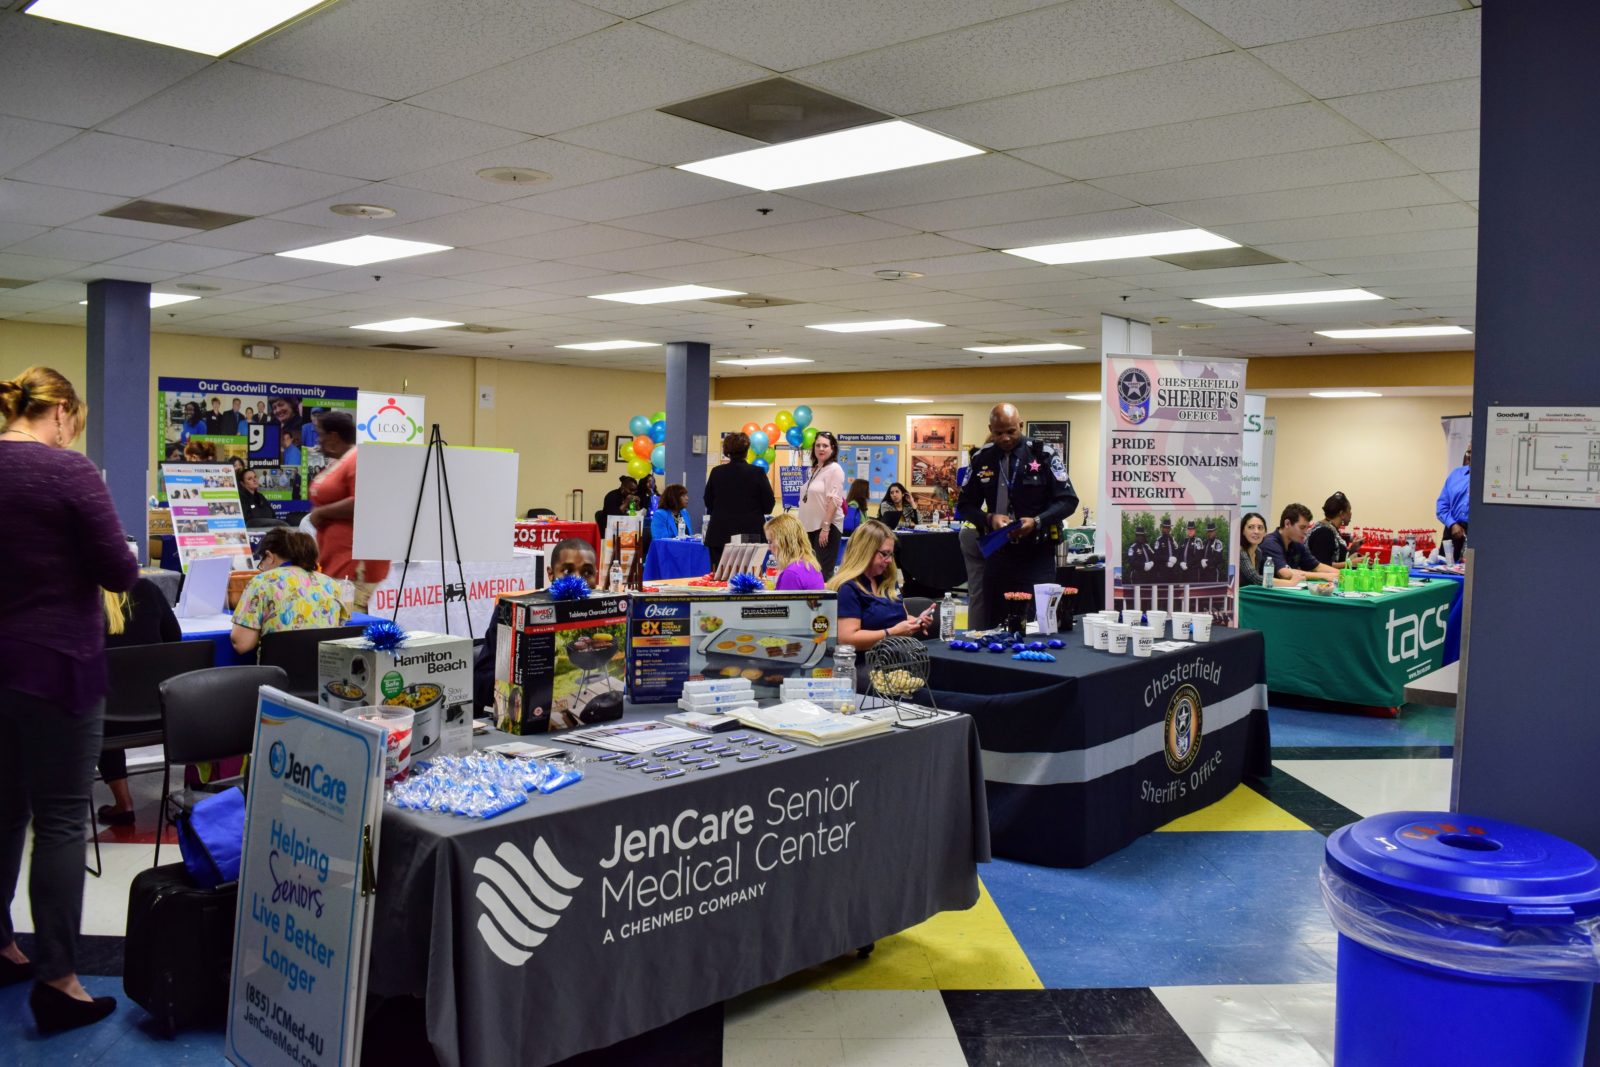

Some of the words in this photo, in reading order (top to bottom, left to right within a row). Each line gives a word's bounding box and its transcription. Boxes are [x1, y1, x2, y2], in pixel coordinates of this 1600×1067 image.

[198, 381, 219, 391] Our
[221, 382, 267, 394] Goodwill
[269, 385, 326, 398] Community
[1157, 377, 1239, 389] CHESTERFIELD
[1157, 389, 1239, 409] SHERIFF'S
[1178, 410, 1218, 421] OFFICE
[1111, 438, 1156, 450] PRIDE
[249, 459, 279, 467] goodwill
[1111, 454, 1239, 467] PROFESSIONALISM
[1111, 471, 1177, 482] HONESTY
[1111, 487, 1186, 499] INTEGRITY
[376, 584, 443, 610] DELHAIZE
[468, 577, 526, 601] AMERICA
[601, 599, 617, 607] 14-inch
[569, 611, 588, 619] Tabletop
[588, 607, 608, 616] Charcoal
[608, 606, 618, 614] Grill
[644, 603, 678, 618] Oster
[641, 620, 660, 635] 8X
[1385, 603, 1449, 664] tacs
[393, 650, 453, 668] Hamilton
[427, 658, 467, 675] Beach
[1144, 657, 1222, 708] Chesterfield
[448, 693, 469, 702] Cooker
[284, 752, 347, 805] JenCare
[1140, 779, 1187, 804] Sheriff's
[1190, 750, 1223, 790] Office
[599, 805, 754, 868] JenCare
[766, 777, 860, 826] Senior
[270, 818, 330, 883] Helping
[601, 842, 741, 918] Medical
[755, 821, 857, 872] Center
[269, 850, 325, 919] Seniors
[602, 928, 615, 945] A
[620, 906, 694, 940] CHENMED
[698, 881, 767, 916] COMPANY
[252, 892, 280, 934] Live
[284, 912, 335, 968] Better
[262, 935, 316, 994] Longer
[245, 982, 270, 1018] (855)
[271, 1003, 324, 1056] JCMed-4U
[244, 1006, 320, 1067] JenCareMed.co
